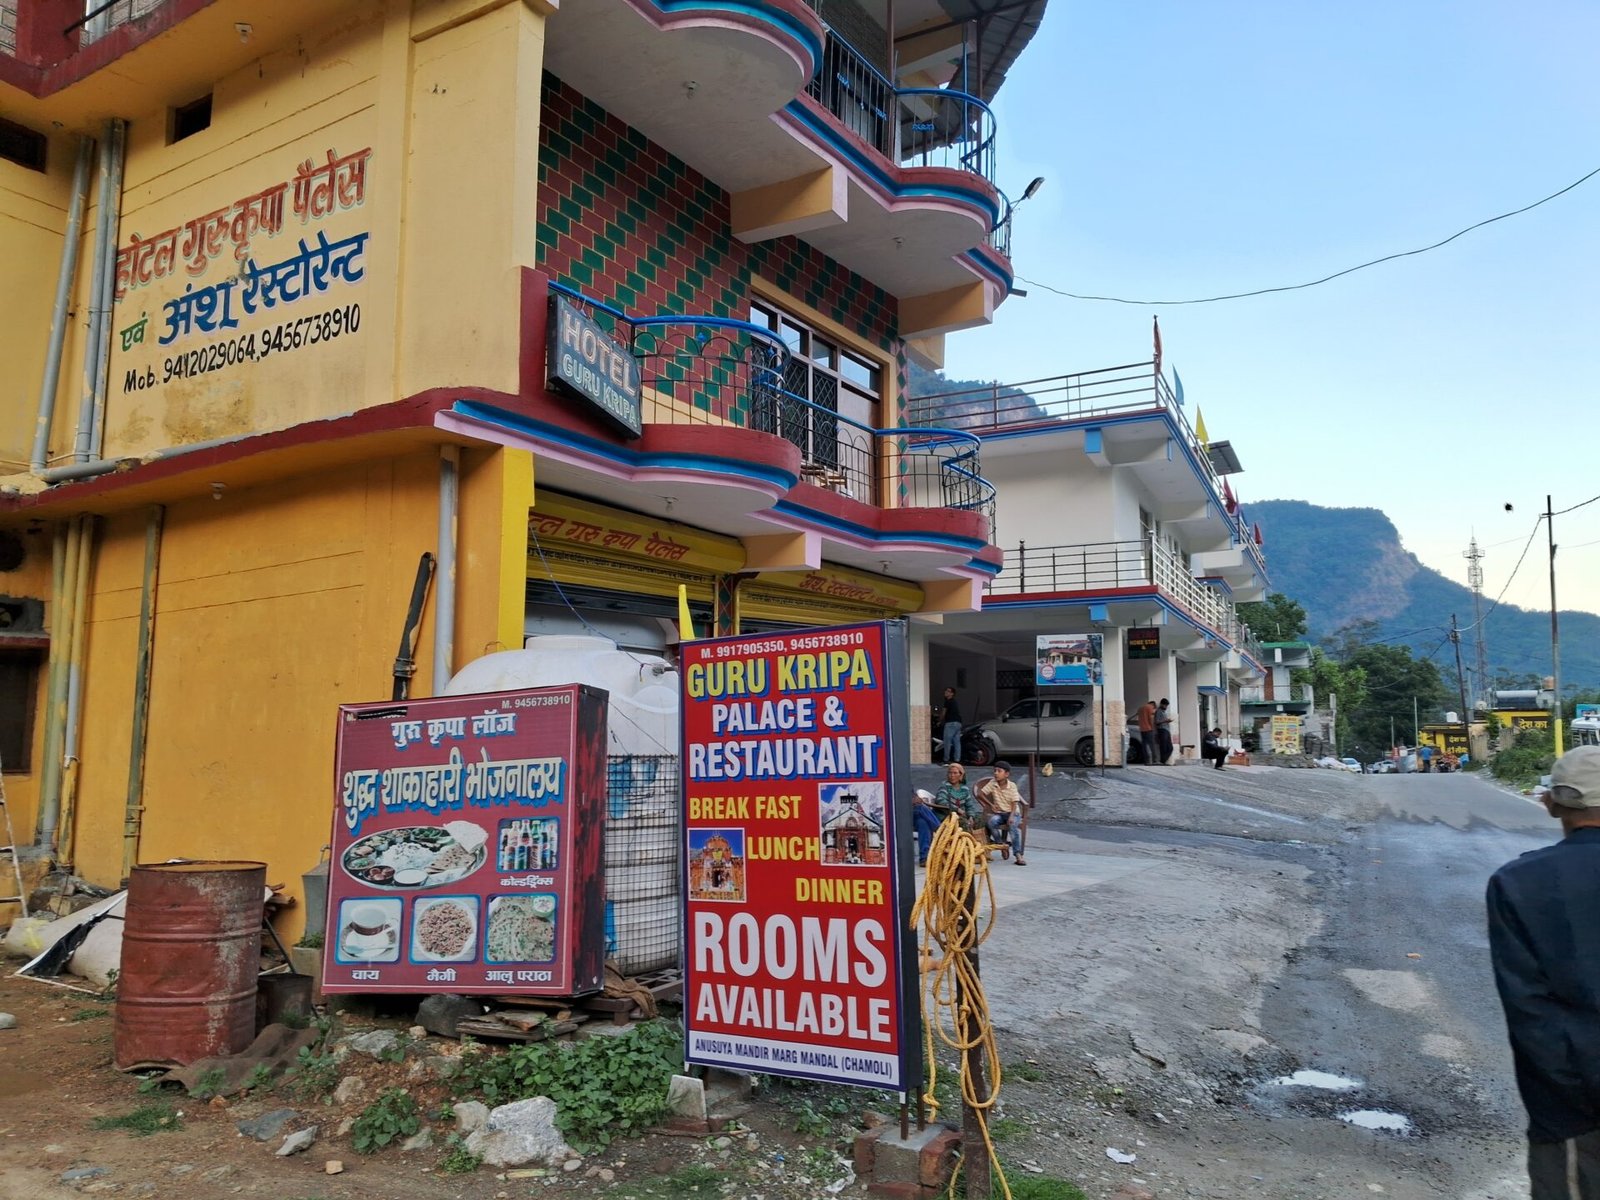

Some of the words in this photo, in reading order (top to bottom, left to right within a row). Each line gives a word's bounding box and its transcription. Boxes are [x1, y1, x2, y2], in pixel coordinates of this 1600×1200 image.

[114, 226, 184, 302] होटल
[291, 146, 372, 223] पैलेस
[119, 310, 149, 352] एवं
[157, 281, 240, 346] अंश
[562, 309, 637, 398] HOTEL
[123, 364, 160, 394] Mob.
[562, 353, 601, 398] GURU
[603, 382, 639, 429] KRIPA
[644, 530, 690, 561] पैलेस
[700, 648, 714, 659] M.
[716, 640, 788, 658] 9917905350,
[790, 632, 864, 651] 9456738910
[687, 657, 768, 699] GURU
[777, 648, 873, 692] KRIPA
[501, 699, 513, 710] M.
[514, 694, 571, 709] 9456738910
[712, 697, 815, 734] PALACE
[822, 695, 845, 728] &
[391, 719, 422, 748] गुरु
[426, 716, 466, 745] कृपा
[471, 708, 516, 736] लॉज
[689, 734, 878, 779] RESTAURANT
[342, 768, 379, 831] शुद्ध
[381, 745, 464, 809] शाकाहारी
[465, 745, 563, 802] भोजनालय
[689, 796, 750, 820] BREAK
[755, 795, 802, 820] FAST
[747, 836, 820, 861] LUNCH
[795, 877, 885, 905] DINNER
[694, 911, 888, 988] ROOMS
[351, 968, 381, 982] चाय
[426, 967, 457, 983] मैगी
[485, 969, 514, 985] आलू
[517, 969, 552, 982] पराठा
[695, 982, 892, 1043] AVAILABLE
[695, 1037, 733, 1055] ANUSUYA
[734, 1042, 770, 1060] MANDIR
[771, 1047, 798, 1065] MARG
[800, 1051, 839, 1070] MANDAL
[841, 1055, 893, 1079] (CHAMOLI)
